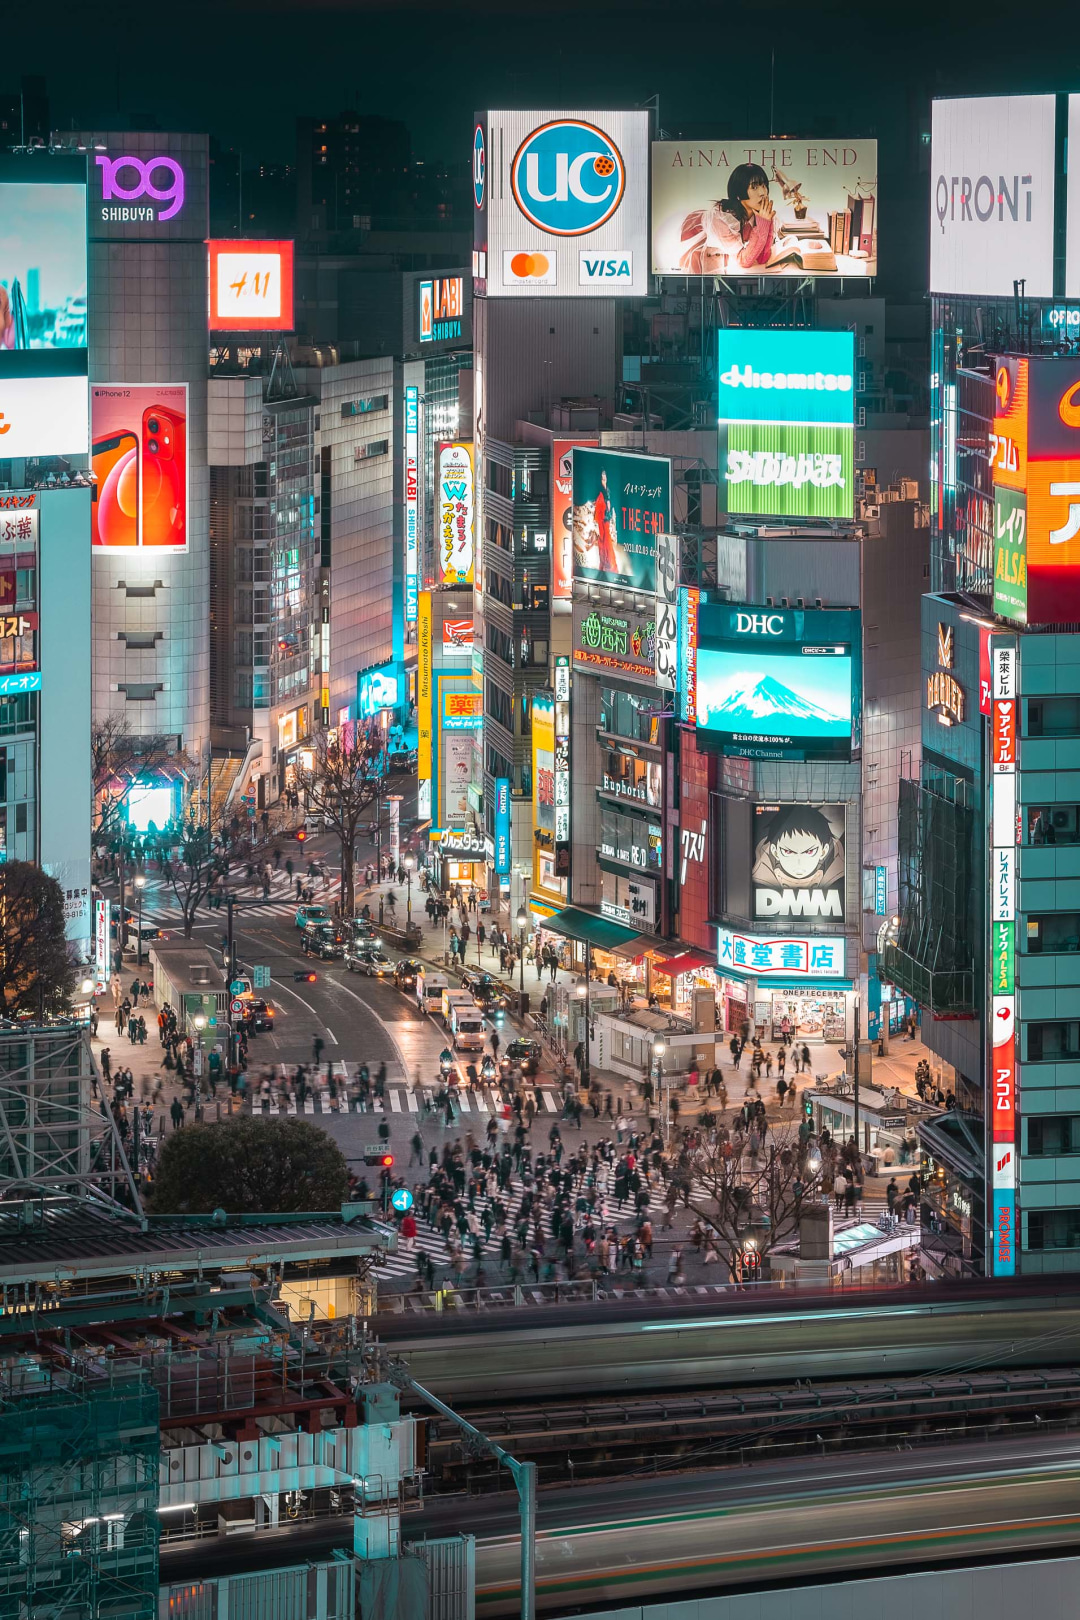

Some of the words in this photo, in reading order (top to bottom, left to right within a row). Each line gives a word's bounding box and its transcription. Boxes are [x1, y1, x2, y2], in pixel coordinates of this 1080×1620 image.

[744, 149, 792, 167] THE
[806, 148, 858, 166] END
[96, 156, 184, 221] 109
[101, 207, 153, 221] SHIBUYA
[582, 259, 631, 277] VISA
[433, 277, 463, 319] LABI
[432, 321, 462, 342] SHIBUYA
[720, 364, 852, 392] Hisamitsu
[406, 401, 417, 434] LABI
[407, 468, 417, 501] LABI
[407, 509, 416, 551] SHIBUYA
[621, 507, 641, 532] THE
[643, 511, 665, 534] END
[997, 503, 1026, 545] レイク
[996, 547, 1026, 589] ALSA
[406, 589, 417, 619] LABI
[421, 616, 429, 648] KiYoshi
[736, 613, 784, 635] DHC
[0, 676, 40, 692] イーオン
[421, 649, 429, 698] Matsumoto
[449, 694, 474, 714] 薬
[926, 671, 965, 724] MAGNET
[756, 749, 783, 758] Channel
[999, 714, 1012, 762] アイフル
[603, 775, 646, 799] Euphoria
[755, 889, 843, 917] DMM
[722, 935, 834, 968] 大盛堂書店
[997, 1068, 1011, 1111] アコム
[998, 1206, 1011, 1263] PROMISE
